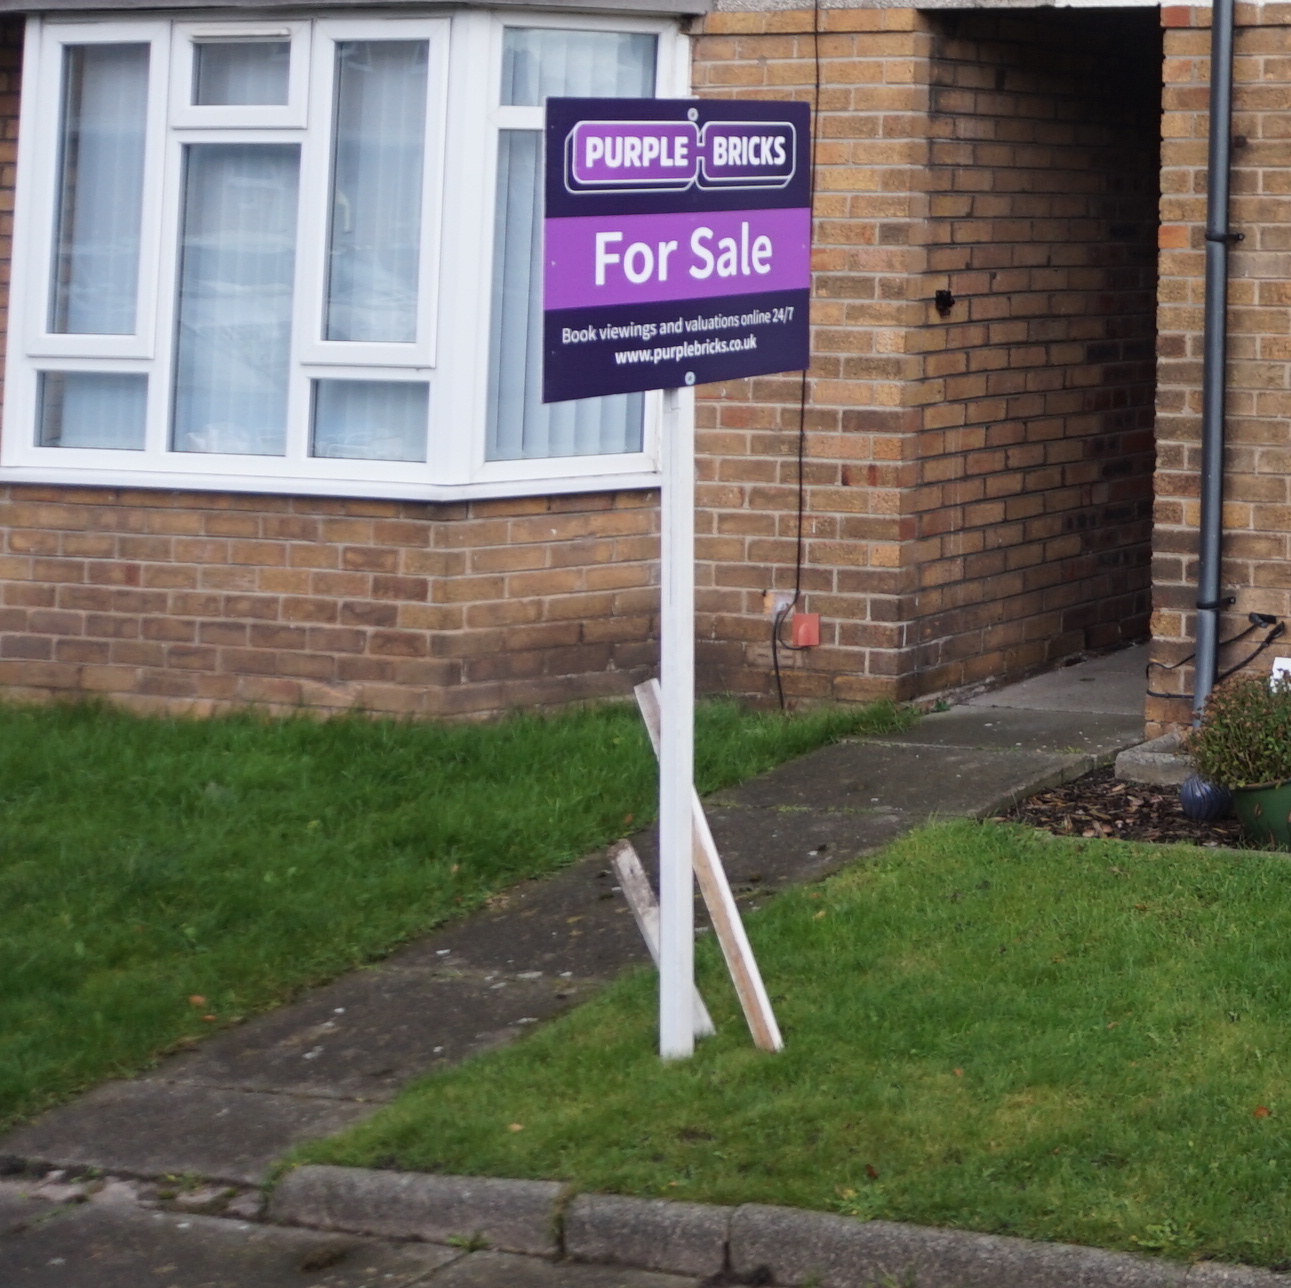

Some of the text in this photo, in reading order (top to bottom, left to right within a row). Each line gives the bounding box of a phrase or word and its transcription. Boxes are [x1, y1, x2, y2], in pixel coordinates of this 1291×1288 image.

[585, 136, 786, 168] PURPLE BRICKS
[595, 222, 773, 286] For Sale
[562, 306, 795, 344] Book viewings and valuations online 24/7
[615, 334, 758, 365] www.purplebricks.co.uk
